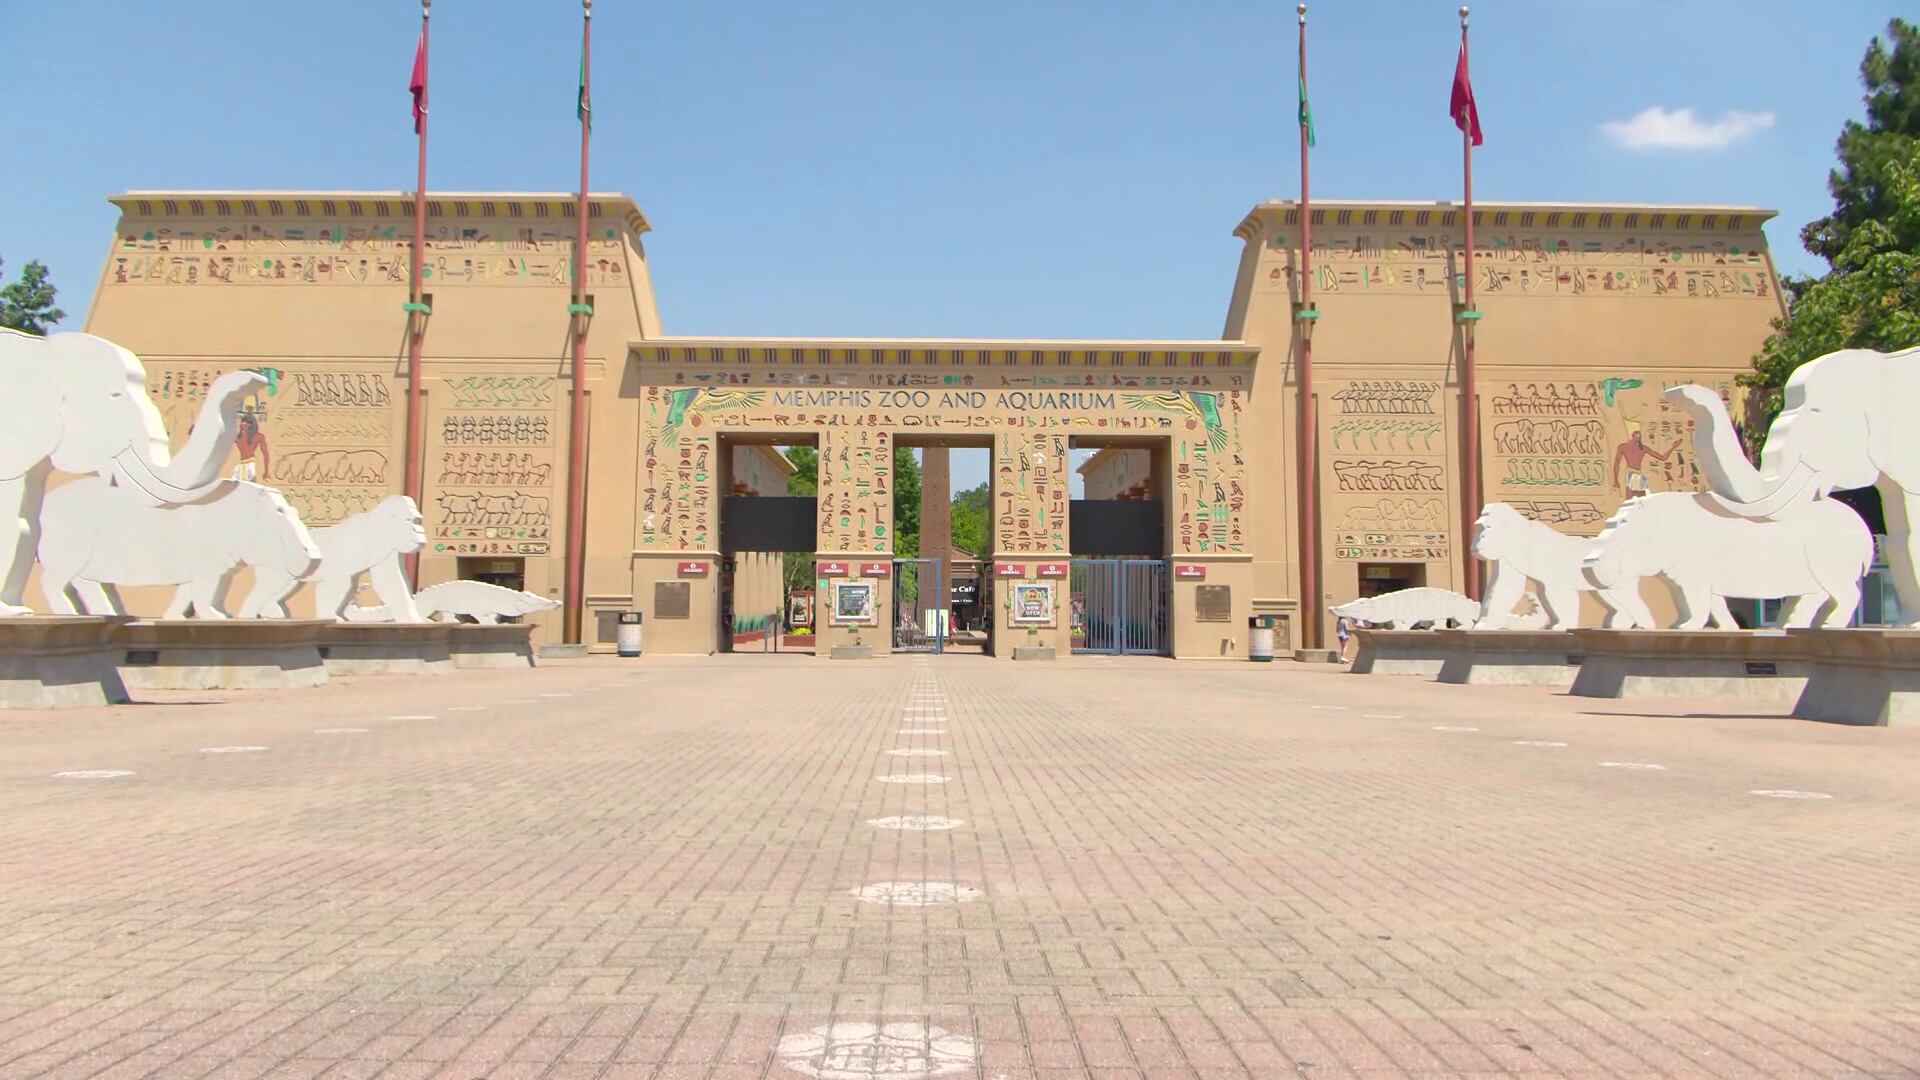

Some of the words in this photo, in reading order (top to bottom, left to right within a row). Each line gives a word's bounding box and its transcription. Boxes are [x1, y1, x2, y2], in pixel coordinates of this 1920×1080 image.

[773, 390, 871, 408] MEMPHIS
[878, 390, 930, 408] ZOO
[938, 391, 987, 409] AND
[995, 391, 1116, 411] AQUARIUM
